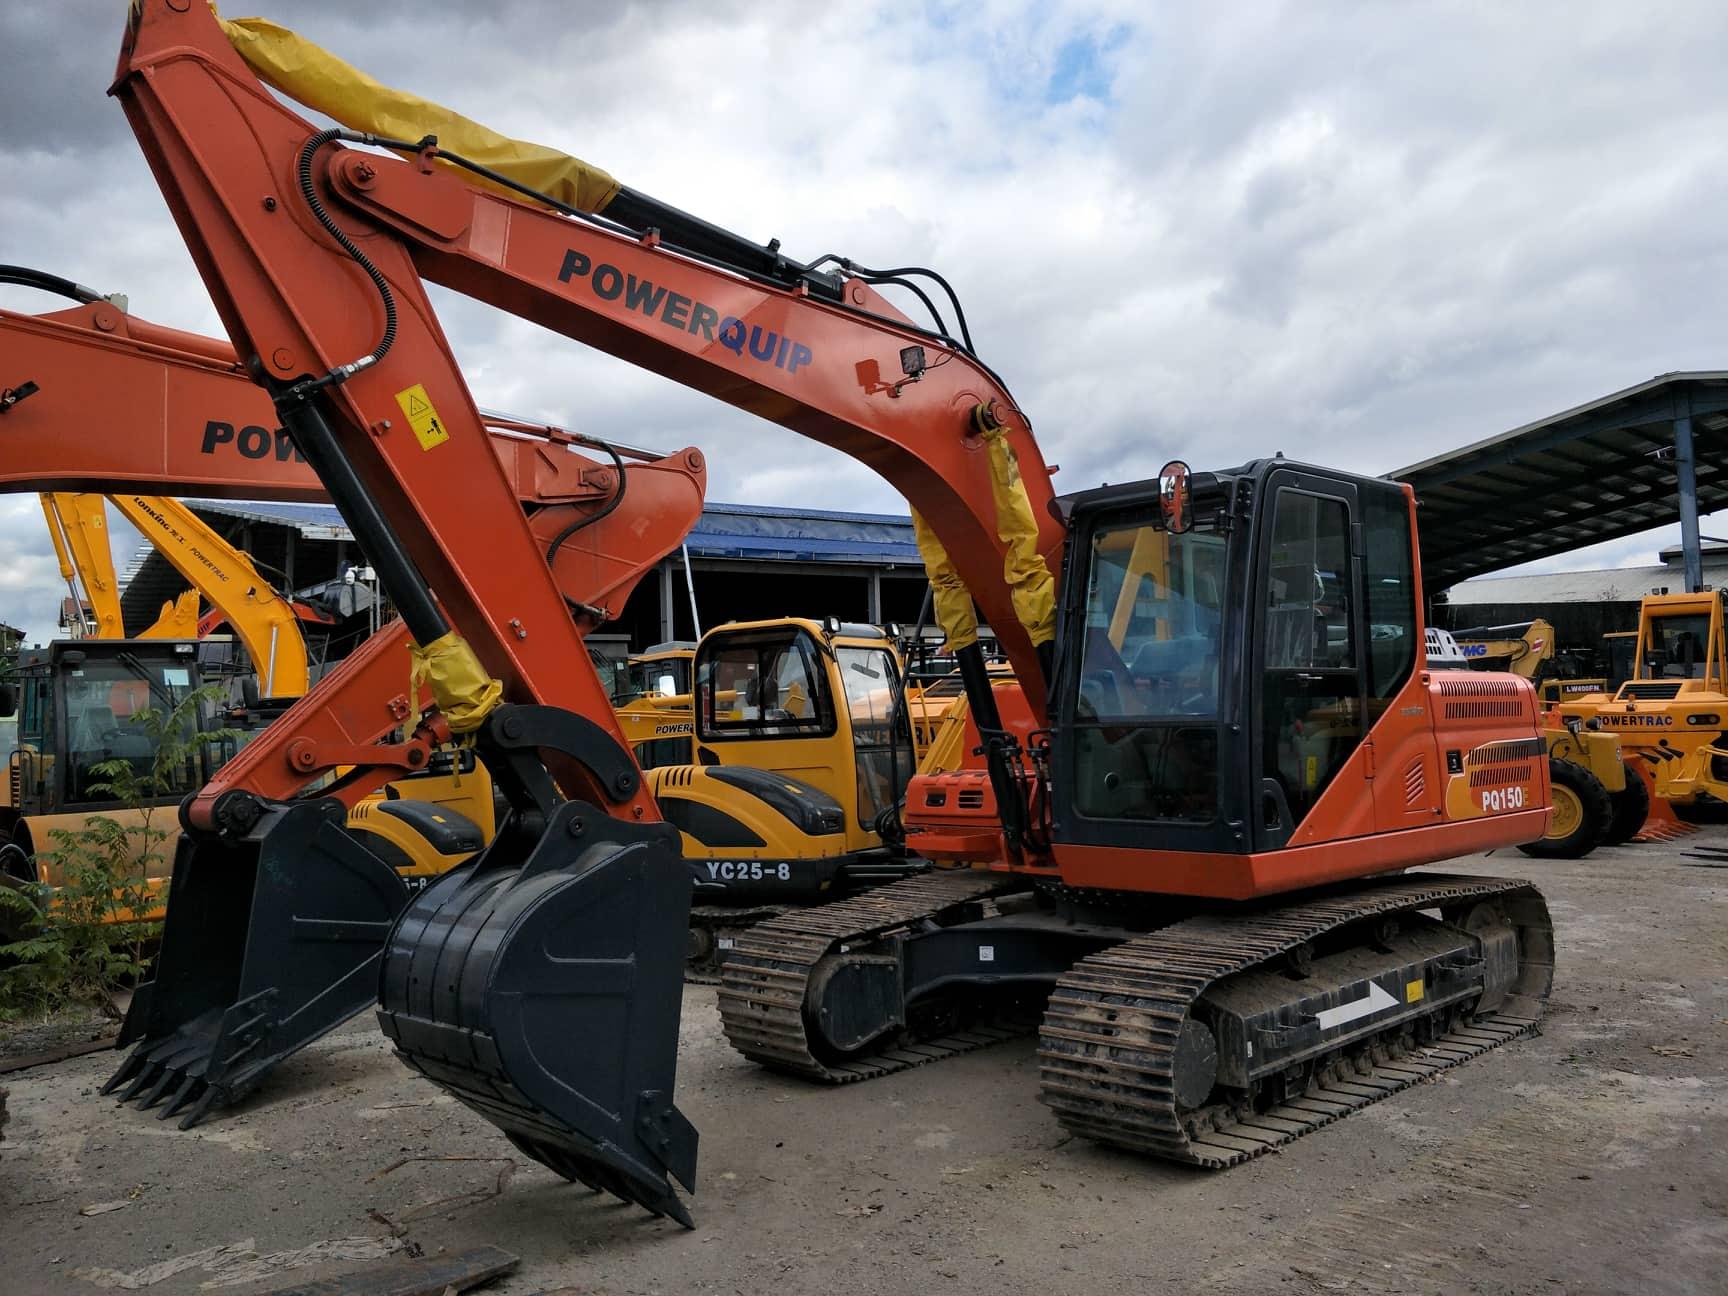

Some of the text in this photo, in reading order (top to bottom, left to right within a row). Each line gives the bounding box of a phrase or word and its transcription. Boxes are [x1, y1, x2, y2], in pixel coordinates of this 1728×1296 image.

[558, 248, 812, 373] POWERQUIP
[190, 547, 230, 582] POWERTRAC
[706, 862, 791, 880] YC25-8
